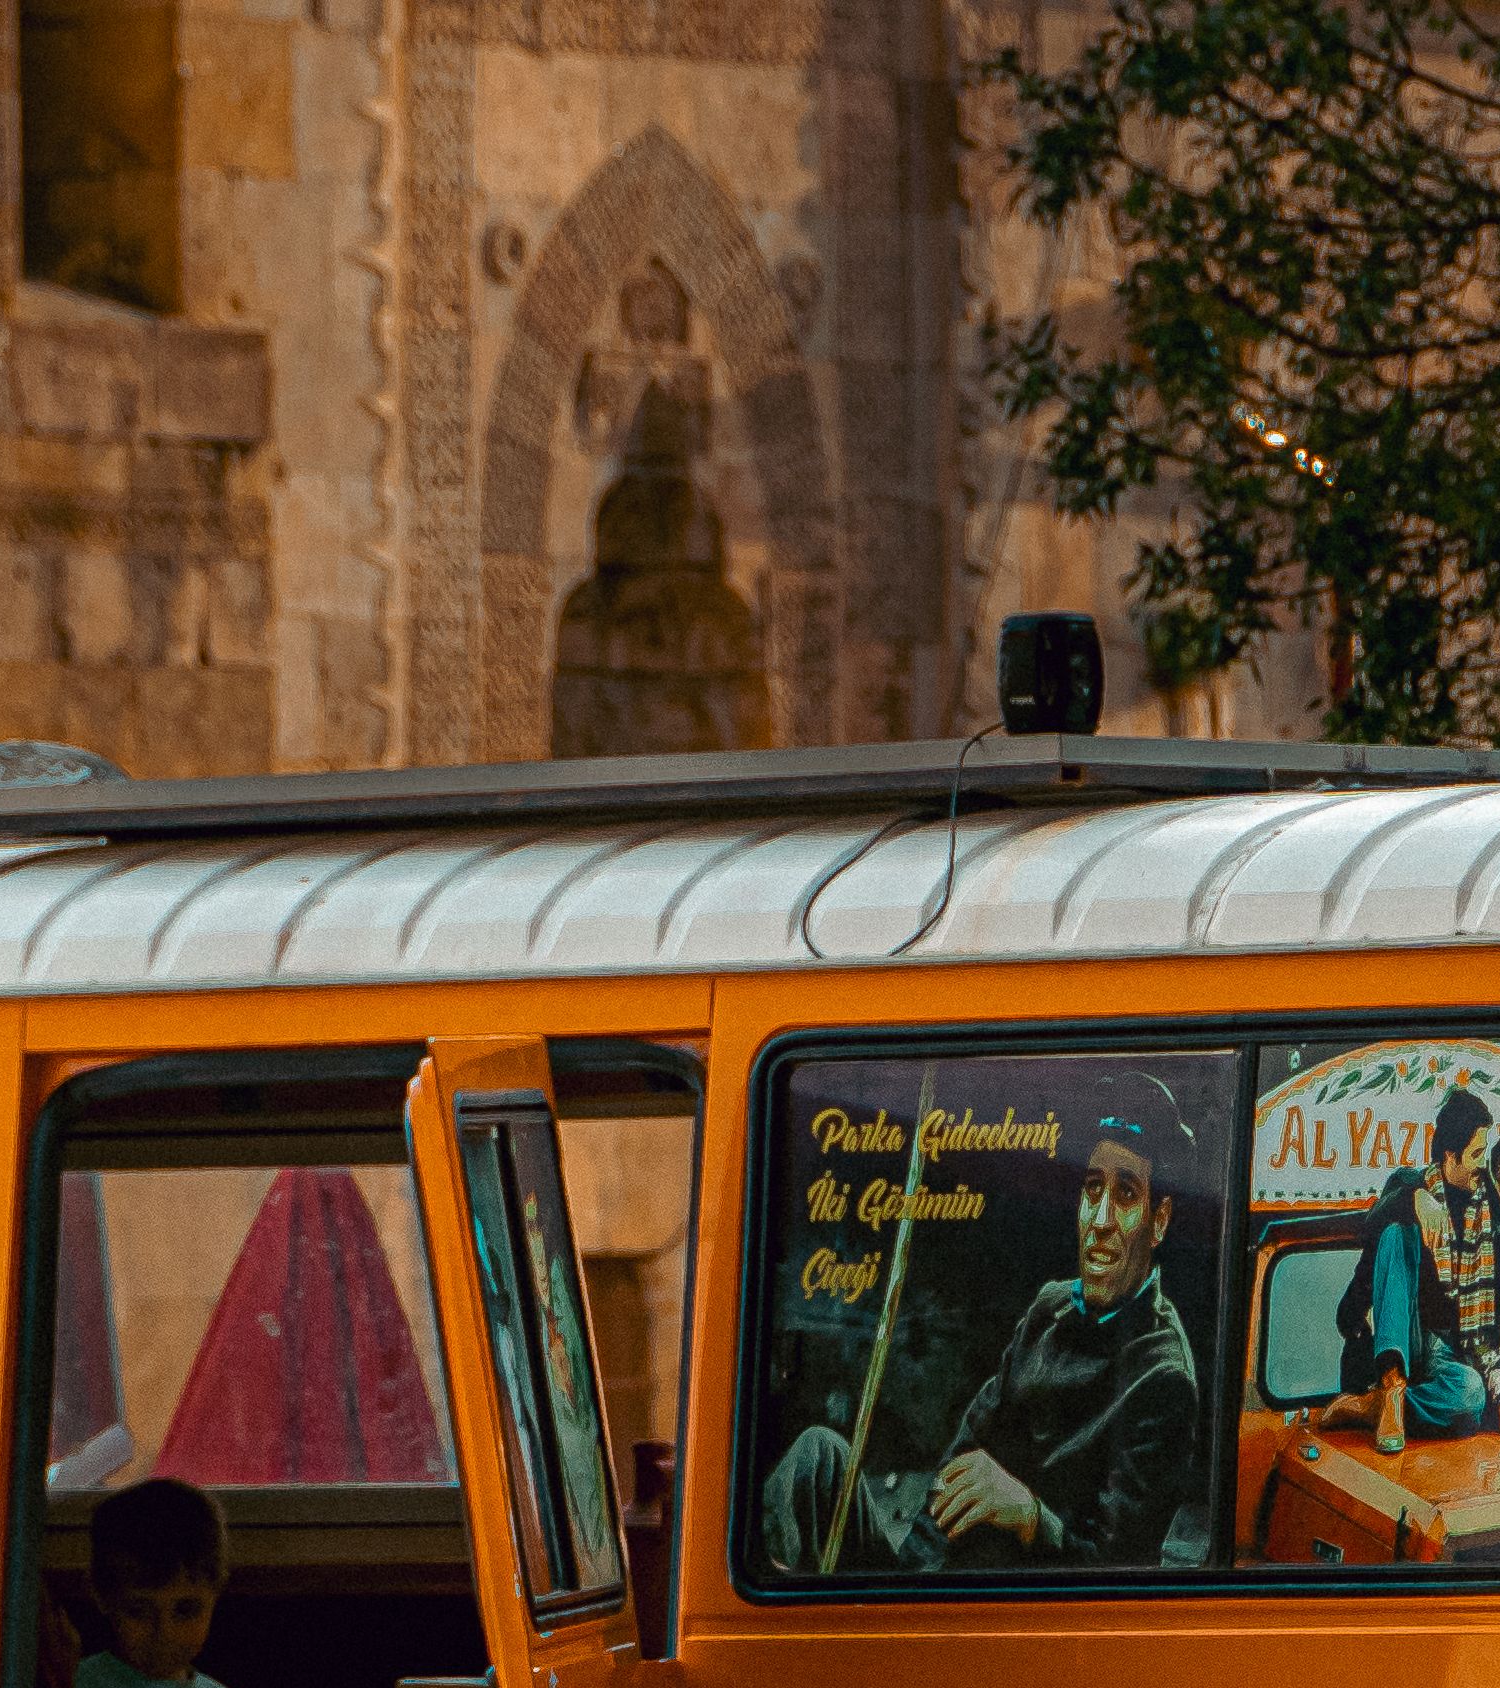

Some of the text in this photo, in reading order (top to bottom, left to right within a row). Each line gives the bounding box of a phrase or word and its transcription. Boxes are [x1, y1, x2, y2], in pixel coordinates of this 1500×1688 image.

[810, 1106, 1063, 1163] Parka Gidecekmiş
[1268, 1105, 1338, 1171] AL
[805, 1169, 852, 1225] İki
